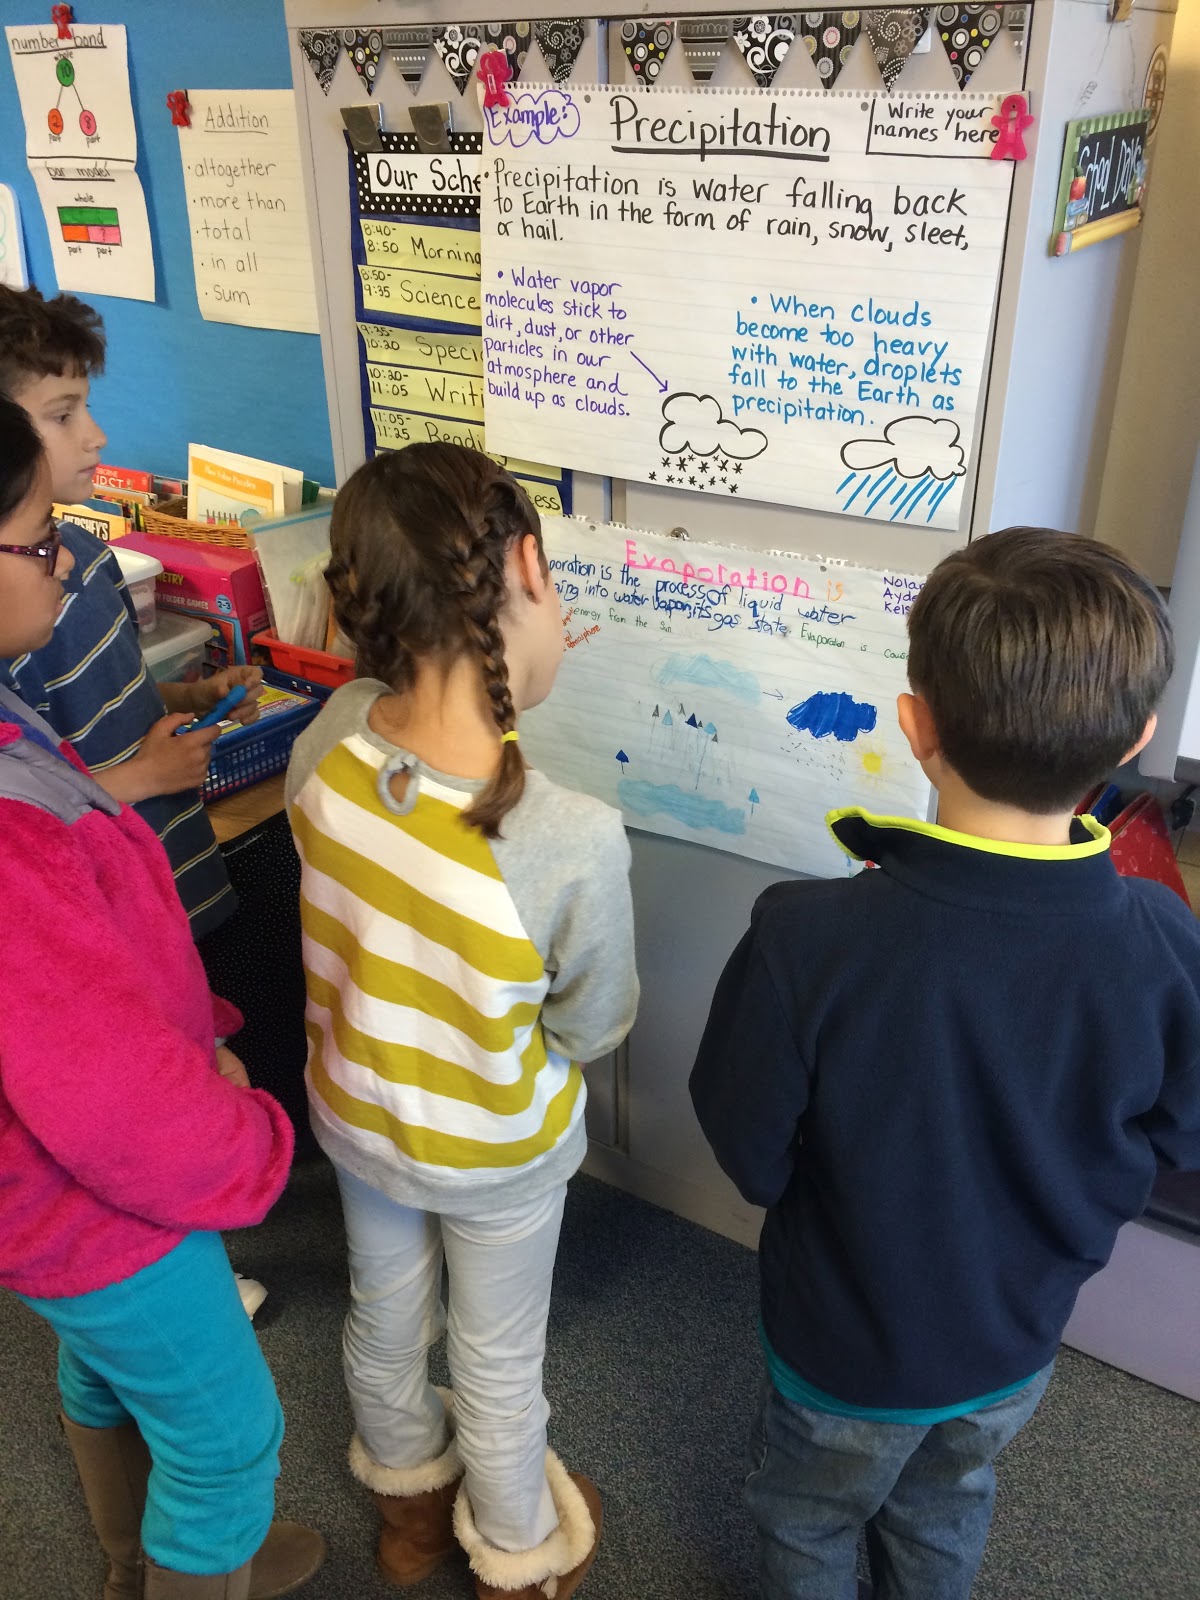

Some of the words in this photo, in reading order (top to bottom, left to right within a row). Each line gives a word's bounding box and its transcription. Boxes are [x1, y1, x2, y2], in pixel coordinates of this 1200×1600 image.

[11, 31, 59, 50] number
[72, 26, 105, 48] bond
[61, 63, 72, 78] 10
[52, 115, 60, 128] 2
[85, 115, 92, 130] 8
[205, 104, 269, 128] Addition
[610, 95, 830, 162] Precipitation
[888, 103, 934, 119] Write
[947, 105, 993, 131] your
[86, 135, 101, 148] part
[874, 123, 938, 141] names
[954, 122, 1000, 143] here
[76, 161, 111, 178] model
[195, 156, 276, 187] altogether
[376, 159, 417, 190] Our
[74, 193, 94, 203] whole
[201, 197, 239, 211] more
[248, 192, 286, 212] than
[494, 158, 638, 200] Precipitation
[659, 178, 676, 197] is
[786, 176, 874, 228] falling
[894, 185, 967, 216] back
[201, 221, 251, 241] total
[494, 186, 512, 214] to
[523, 191, 579, 218] Earth
[590, 201, 607, 220] in
[618, 201, 653, 224] the
[663, 203, 715, 230] form
[726, 208, 751, 231] of
[766, 216, 819, 245] rain,
[828, 220, 892, 251] snow,
[905, 221, 969, 250] sleet,
[497, 223, 511, 236] or
[523, 218, 564, 241] hail.
[68, 246, 82, 256] part
[96, 247, 112, 258] part
[367, 239, 399, 253] 8:50
[211, 259, 226, 271] in
[236, 252, 258, 272] all
[364, 284, 391, 298] 9:35
[400, 280, 481, 309] Science
[511, 267, 561, 290] Water
[570, 279, 622, 300] vapor
[485, 290, 554, 314] molecules
[563, 299, 603, 319] stick
[608, 301, 627, 320] to
[770, 293, 835, 320] When
[850, 297, 932, 327] clouds
[485, 310, 521, 338] dirt,
[524, 317, 563, 342] dust,
[565, 327, 582, 341] or
[589, 325, 635, 346] other
[736, 310, 808, 342] become
[820, 323, 854, 347] too
[873, 331, 949, 369] heavy
[366, 338, 400, 351] 10:20
[484, 337, 544, 359] particles
[553, 345, 568, 363] in
[576, 352, 611, 367] our
[487, 358, 577, 388] atmosphere
[586, 373, 628, 396] and
[732, 343, 777, 366] with
[789, 351, 856, 379] water,
[863, 352, 962, 387] droplets
[372, 381, 409, 397] 11:05
[487, 378, 520, 401] build
[525, 391, 545, 409] up
[552, 394, 566, 408] as
[575, 395, 630, 417] clouds.
[728, 364, 766, 388] fall
[777, 370, 798, 391] to
[808, 375, 843, 396] the
[858, 380, 920, 407] Earth
[932, 393, 955, 411] as
[732, 394, 874, 426] precipitation.
[377, 425, 410, 440] 11:25
[64, 514, 108, 541] SHEY'S
[156, 571, 184, 586] METRY
[585, 580, 608, 599] into
[614, 589, 649, 606] water
[708, 613, 742, 632] gas
[601, 565, 612, 581] is
[620, 563, 641, 588] the
[655, 580, 706, 602] process
[739, 586, 784, 618] liquid
[797, 604, 857, 626] water
[635, 615, 648, 628] the
[860, 643, 867, 652] is
